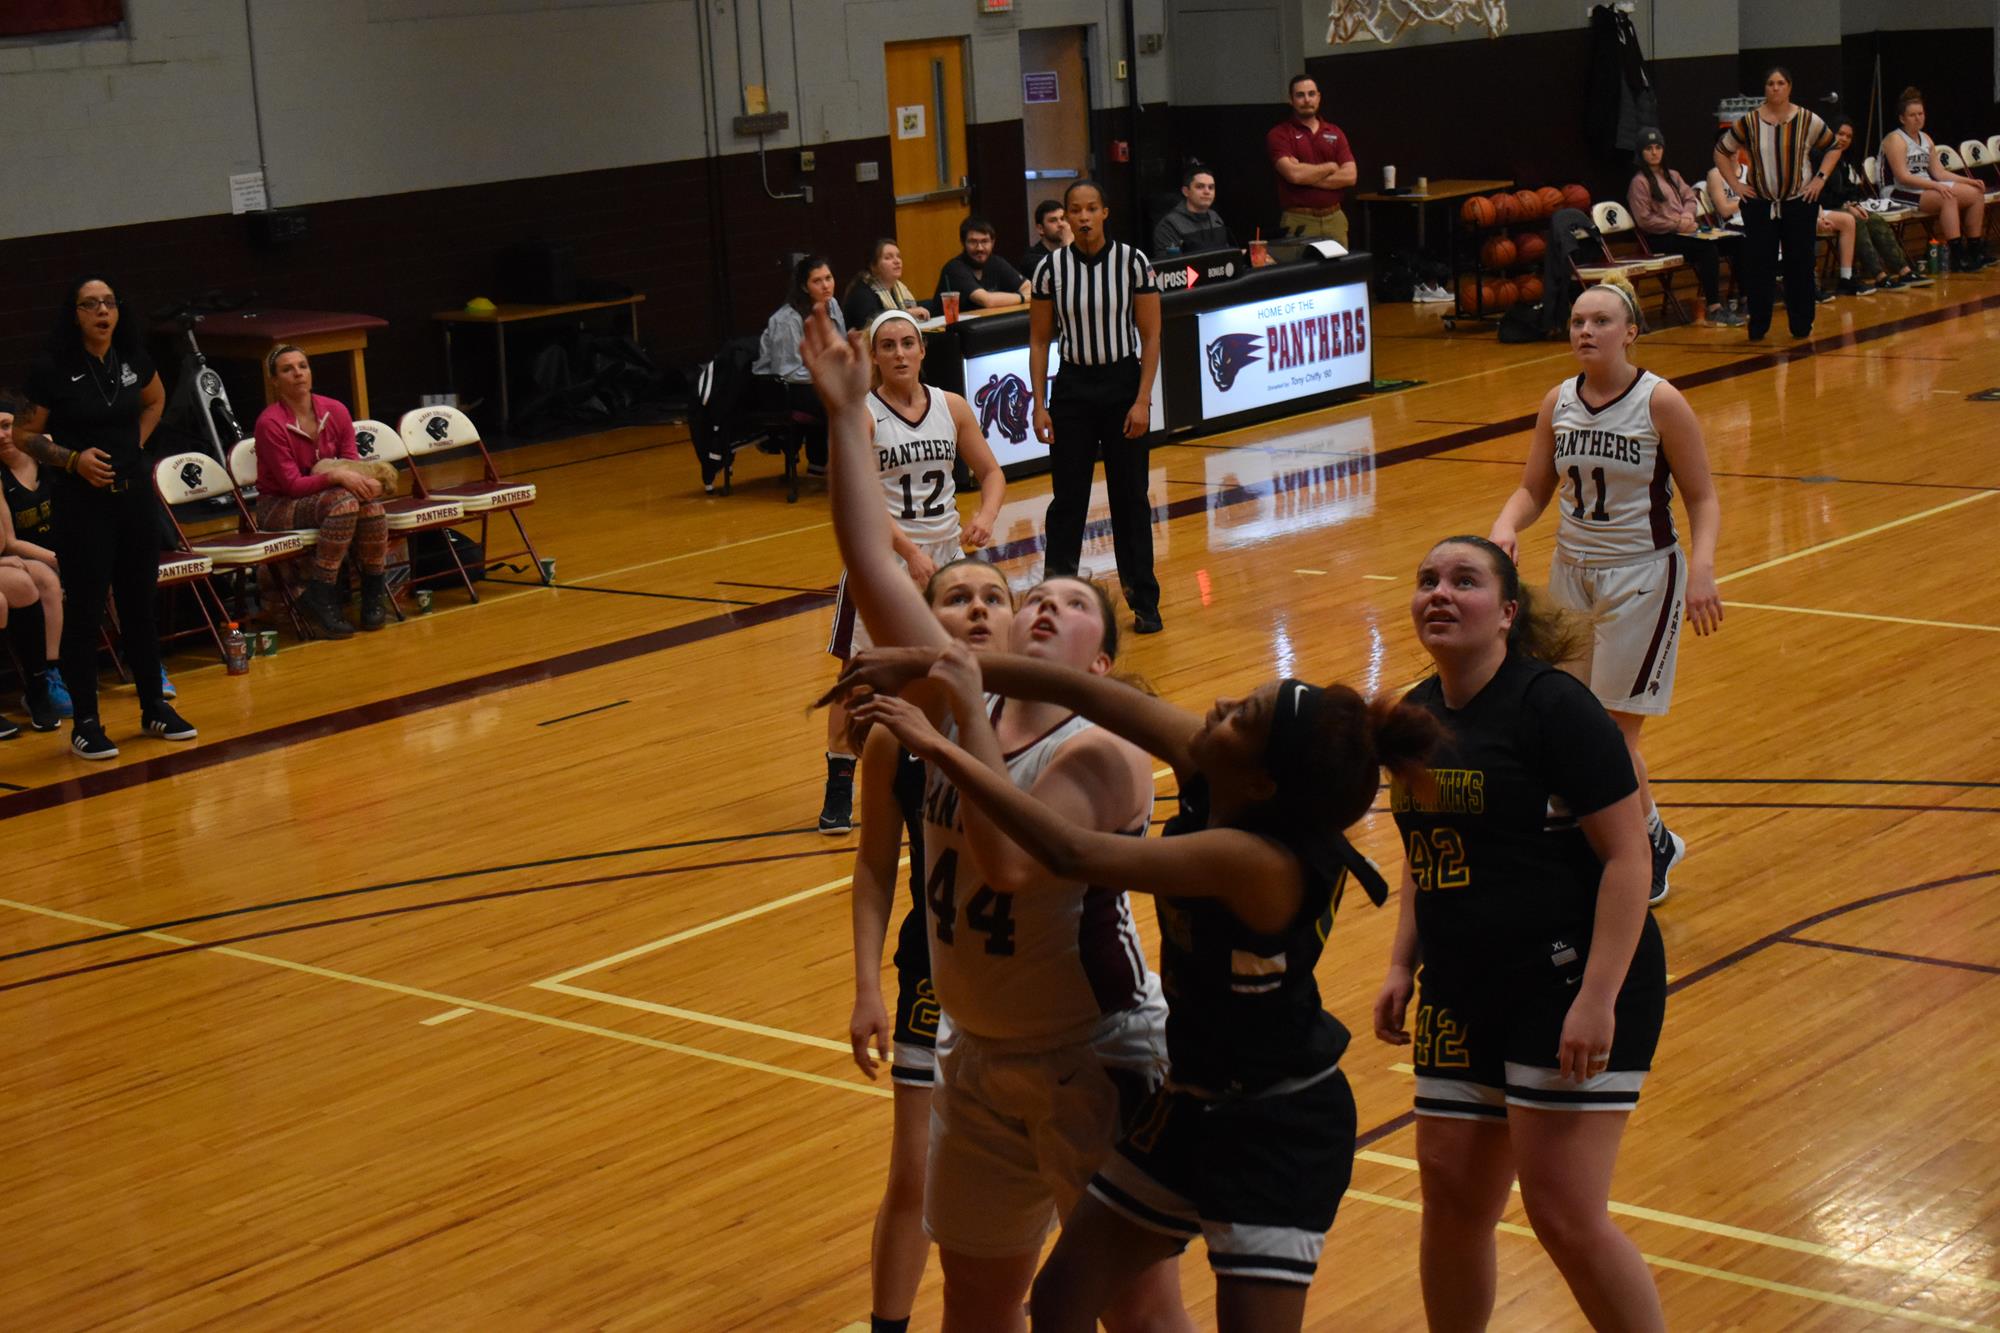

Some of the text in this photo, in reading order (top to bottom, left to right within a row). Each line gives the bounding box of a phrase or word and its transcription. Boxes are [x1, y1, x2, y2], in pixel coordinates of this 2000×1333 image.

[1163, 270, 1188, 289] POSS
[1257, 299, 1315, 319] HOME OF THE
[1266, 306, 1366, 373] PANTHERS
[491, 490, 531, 505] PANTHERS
[899, 469, 946, 519] 12
[1568, 465, 1610, 522] 11
[416, 507, 458, 523] PANTHERS
[264, 538, 302, 555] PANTHERS
[158, 561, 206, 579] PANTHERS
[1408, 828, 1471, 892] 42
[927, 847, 1016, 957] 44
[1551, 940, 1568, 952] XL
[1415, 1004, 1471, 1068] 42
